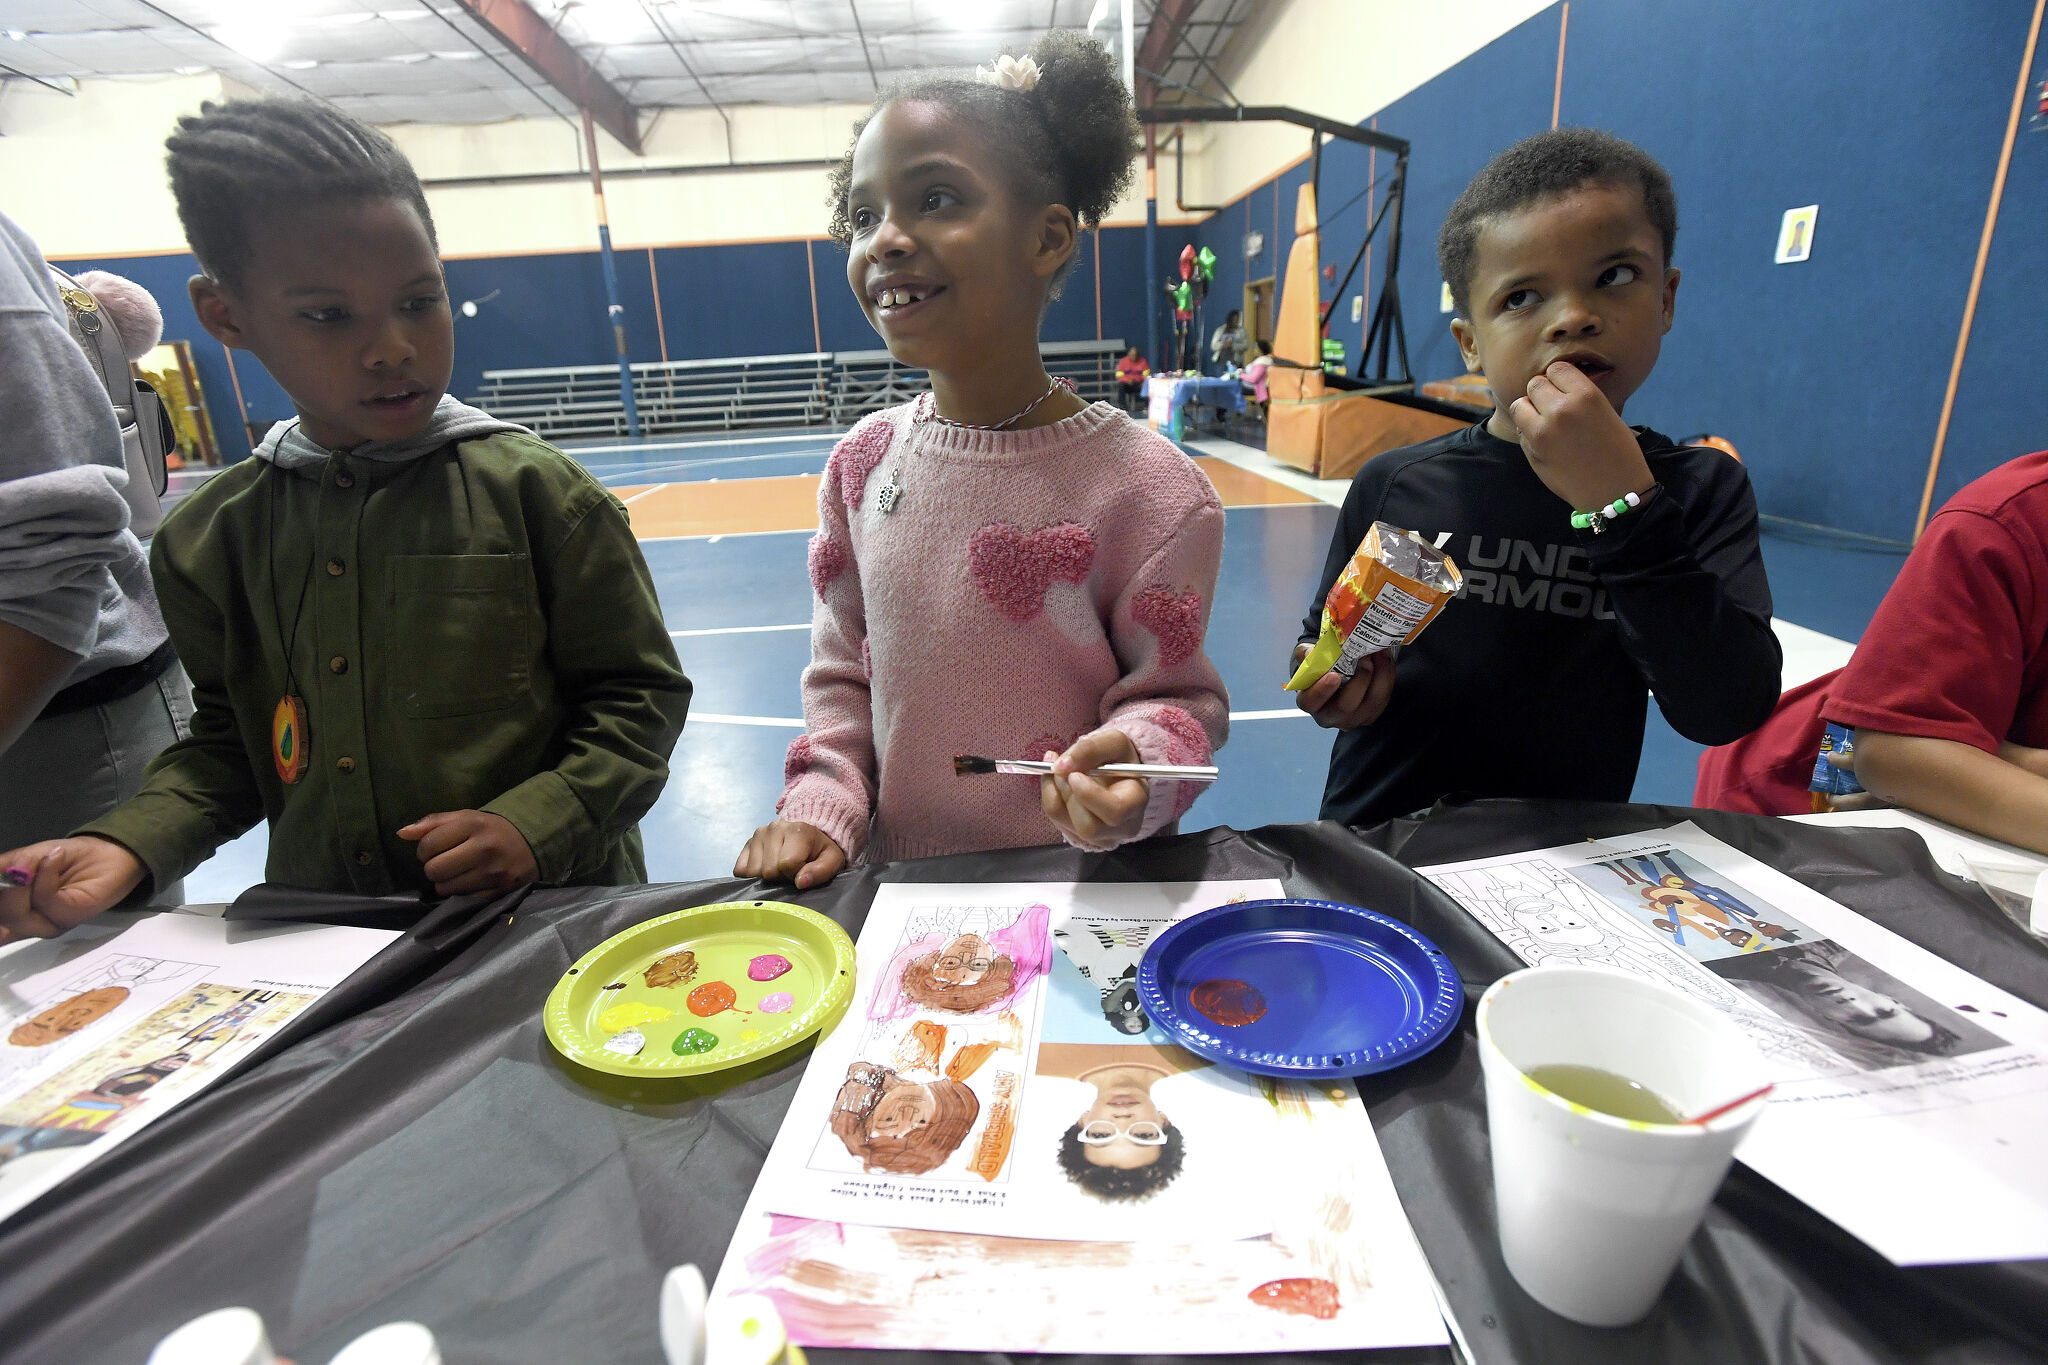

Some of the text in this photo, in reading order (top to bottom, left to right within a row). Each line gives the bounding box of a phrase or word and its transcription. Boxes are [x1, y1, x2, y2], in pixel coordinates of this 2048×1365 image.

[1468, 535, 1596, 581] UND
[1370, 604, 1402, 624] Nutrition
[1355, 627, 1381, 643] Calories
[843, 1181, 870, 1189] brown
[873, 1183, 896, 1191] Light
[831, 1189, 858, 1197] Yellow
[972, 1198, 996, 1206] Light
